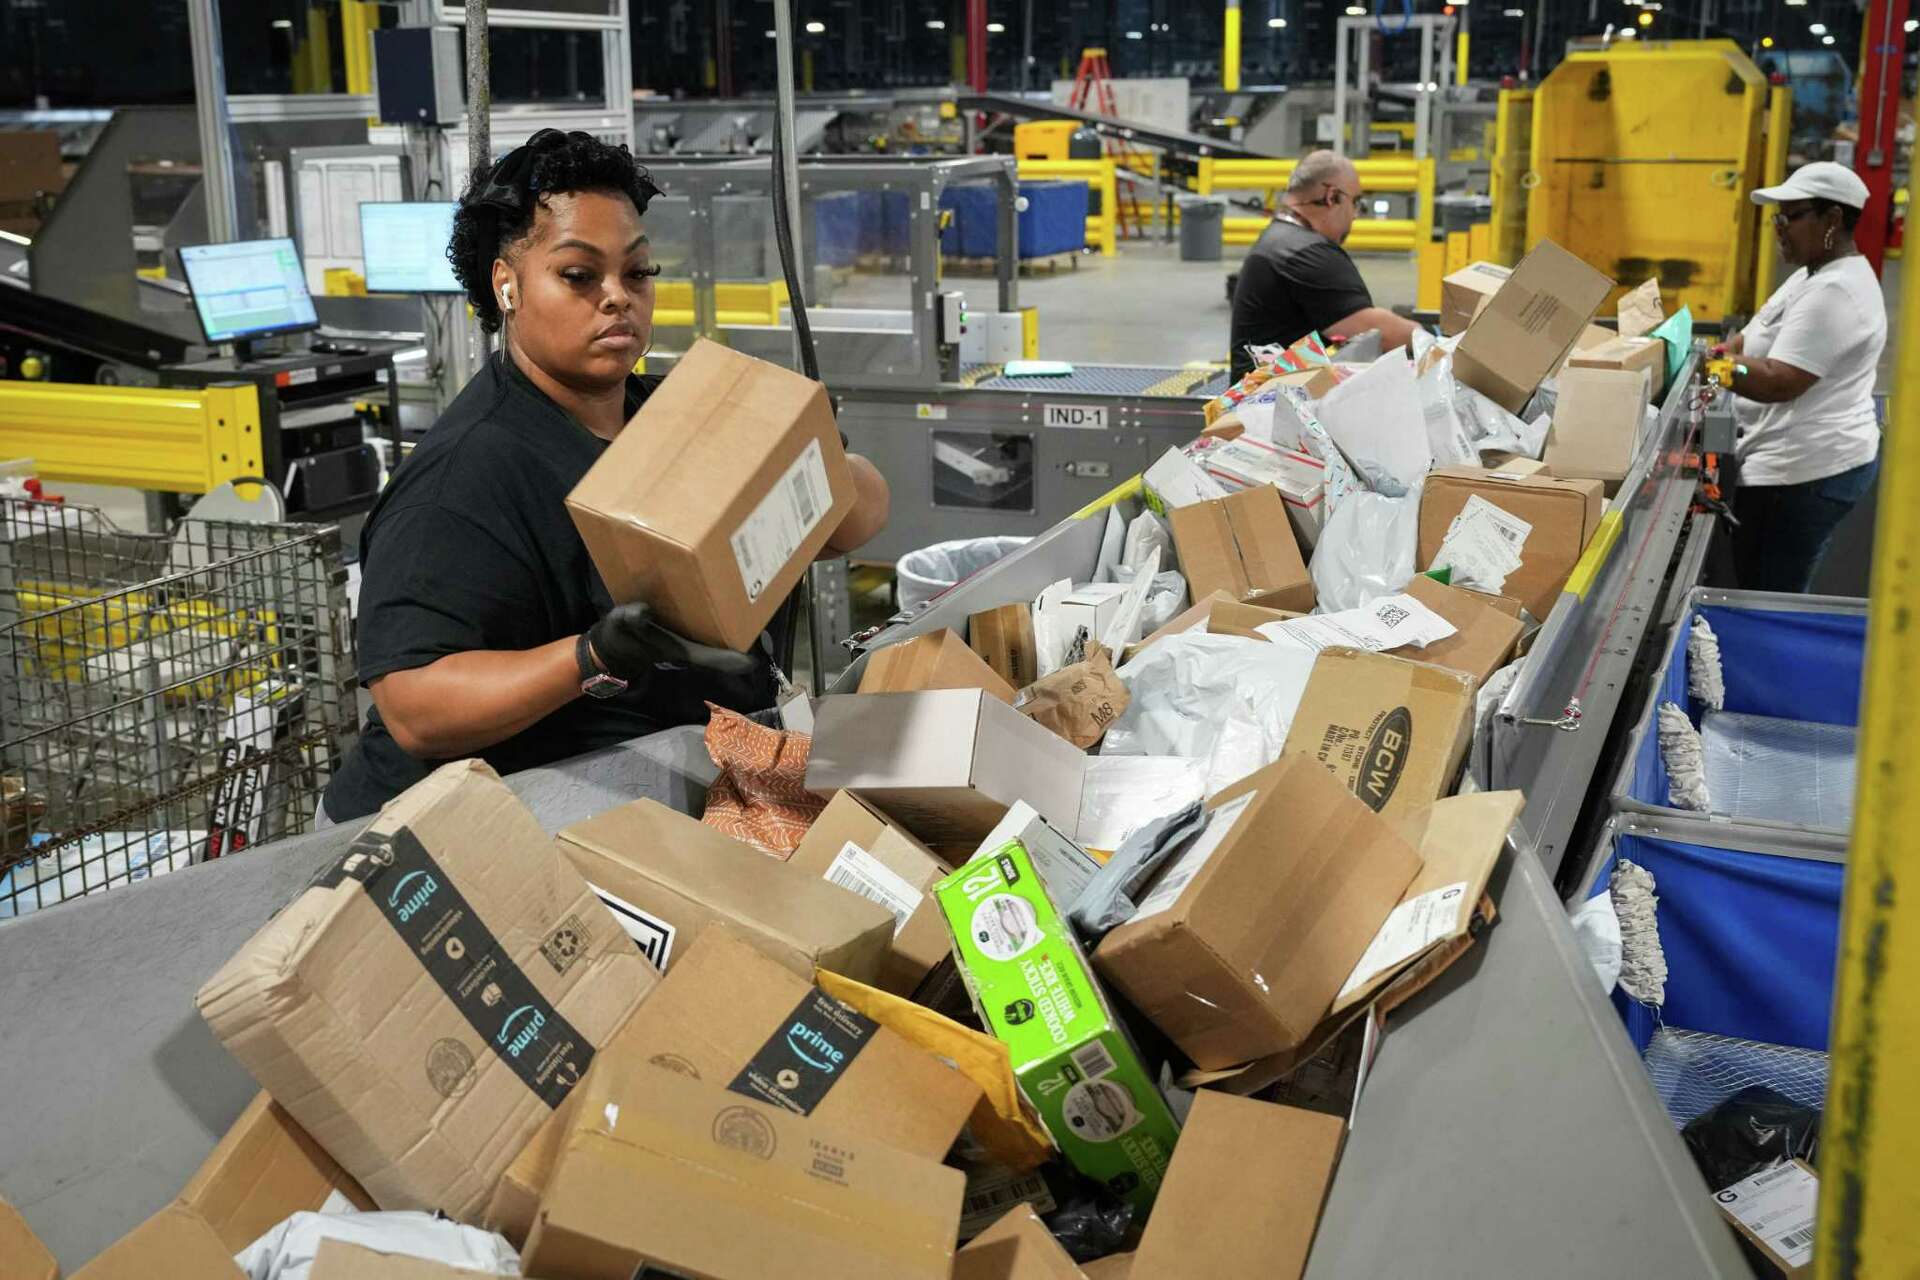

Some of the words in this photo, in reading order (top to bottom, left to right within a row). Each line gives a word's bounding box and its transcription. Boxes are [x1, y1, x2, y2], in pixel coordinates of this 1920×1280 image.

[1050, 407, 1101, 425] IND-1
[1090, 702, 1113, 728] M8
[1323, 723, 1339, 743] MADE
[1320, 742, 1332, 752] IN
[1367, 729, 1402, 797] BCW
[1001, 858, 1017, 880] BOWLS
[962, 866, 1002, 902] 12
[1442, 889, 1460, 900] G
[397, 874, 438, 922] prime
[1020, 959, 1047, 998] STICKY
[1039, 960, 1058, 987] RICE
[817, 997, 834, 1012] free
[1052, 984, 1076, 1024] WHITE
[507, 1008, 546, 1057] prime
[1039, 996, 1068, 1043] COOKED
[789, 1021, 844, 1063] prime
[1037, 1072, 1068, 1096] 12
[1716, 1190, 1738, 1203] G
